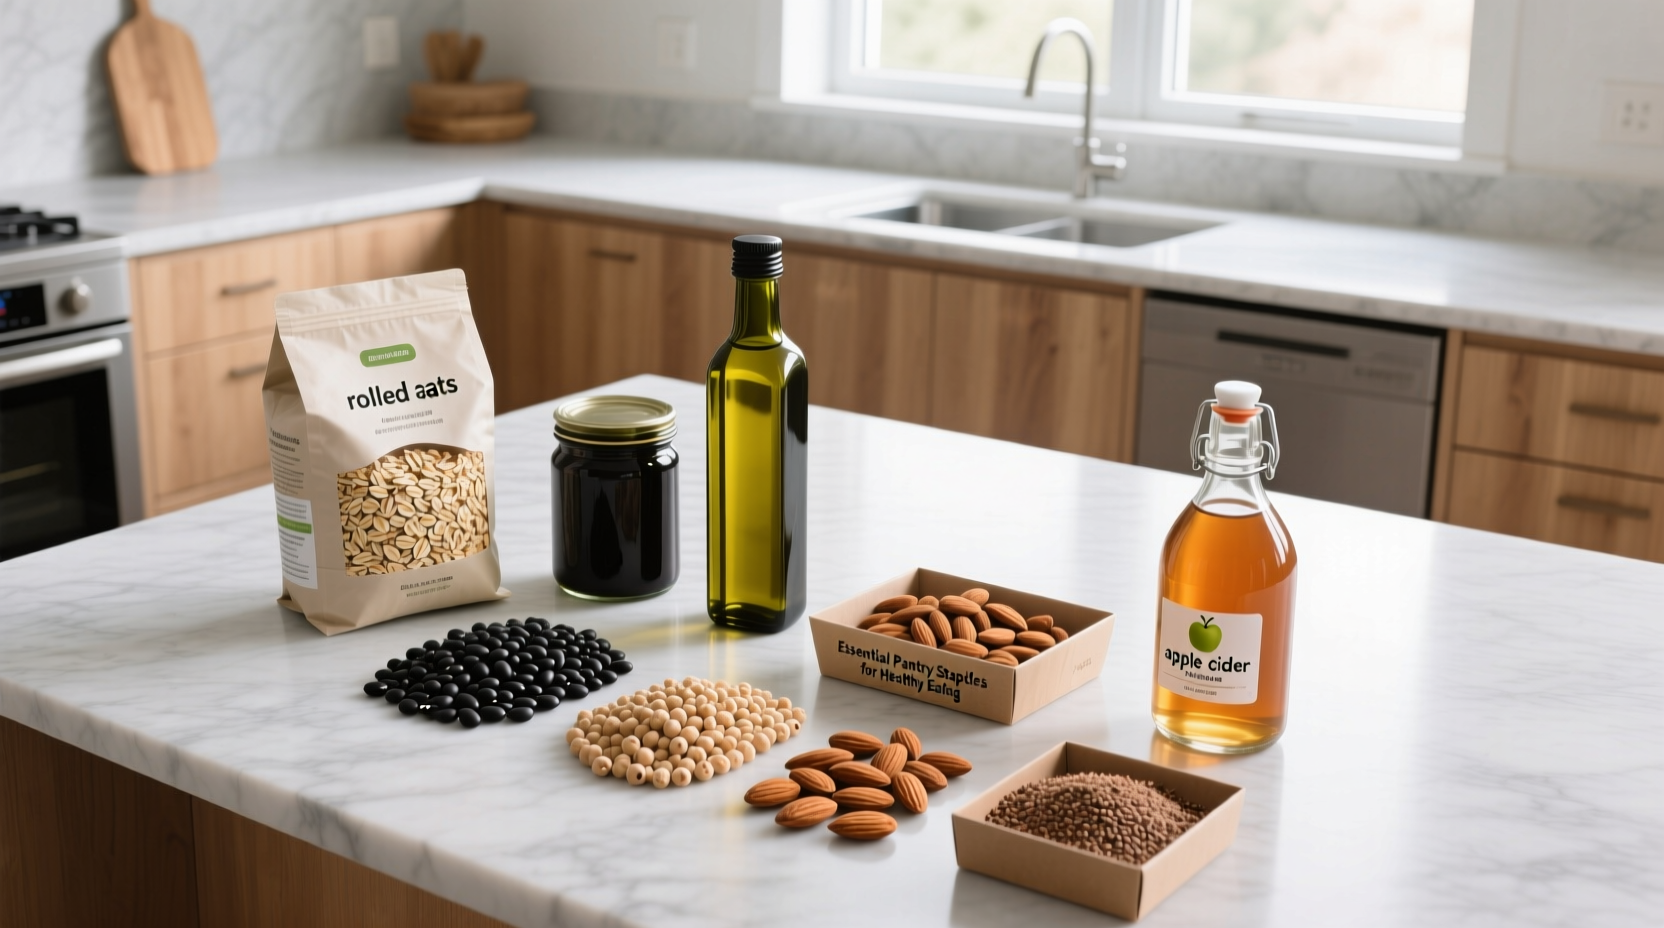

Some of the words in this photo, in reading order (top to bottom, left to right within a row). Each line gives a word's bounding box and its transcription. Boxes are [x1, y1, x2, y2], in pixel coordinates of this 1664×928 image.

[347, 380, 410, 410] rolled
[838, 640, 890, 665] Essential
[893, 654, 934, 678] Pantry
[860, 661, 878, 677] for
[1164, 648, 1203, 670] apple
[1208, 656, 1251, 672] cider
